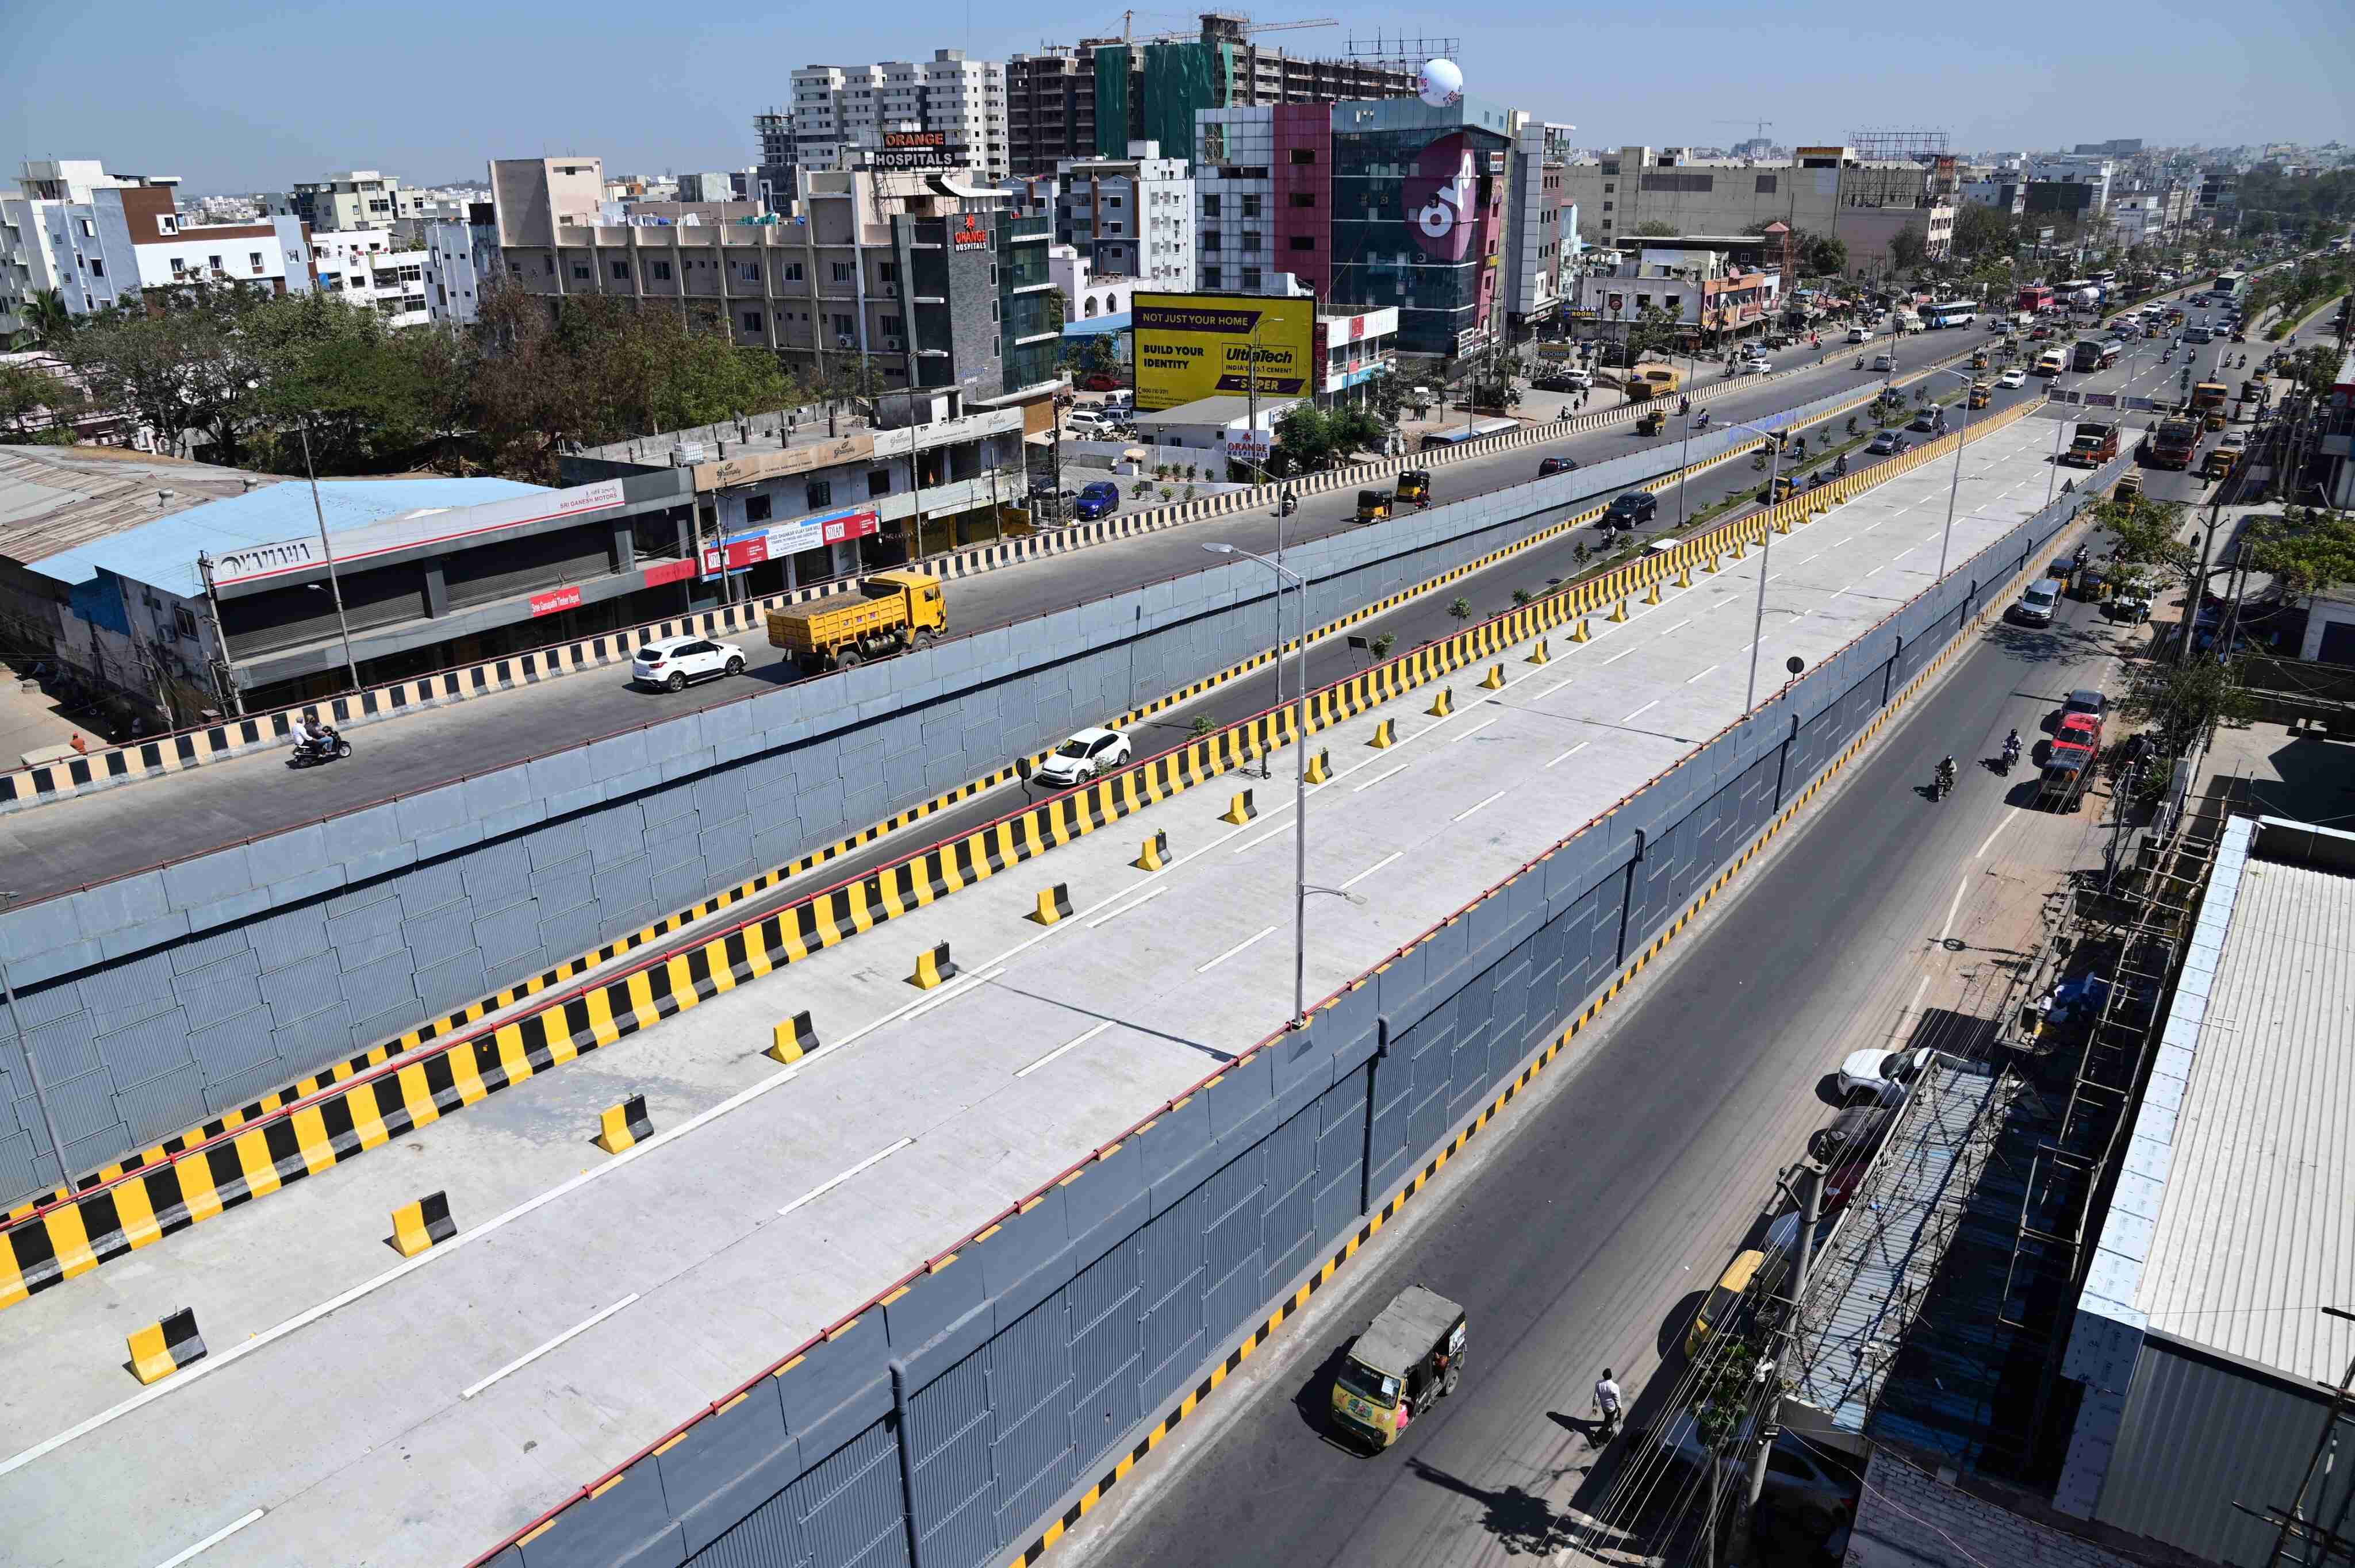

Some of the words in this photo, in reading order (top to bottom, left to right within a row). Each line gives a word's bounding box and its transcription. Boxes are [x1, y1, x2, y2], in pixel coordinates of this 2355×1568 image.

[885, 133, 943, 146] ORANGE
[876, 152, 952, 166] HOSPITALS
[956, 230, 985, 243] ORANGE
[956, 242, 987, 251] HOSPITALS
[1143, 313, 1163, 322] NOT
[1165, 314, 1187, 323] JUST
[1188, 316, 1215, 325] YOUR
[1218, 317, 1248, 326] HOME
[1144, 345, 1173, 355] BUILD
[1175, 347, 1204, 356] YOUR
[1144, 359, 1190, 369] IDENTITY
[1241, 379, 1279, 390] SPER
[1228, 442, 1267, 452] ORANGE
[570, 498, 593, 506] GANESH
[594, 493, 617, 502] MOTORS
[709, 551, 728, 567] STYLM
